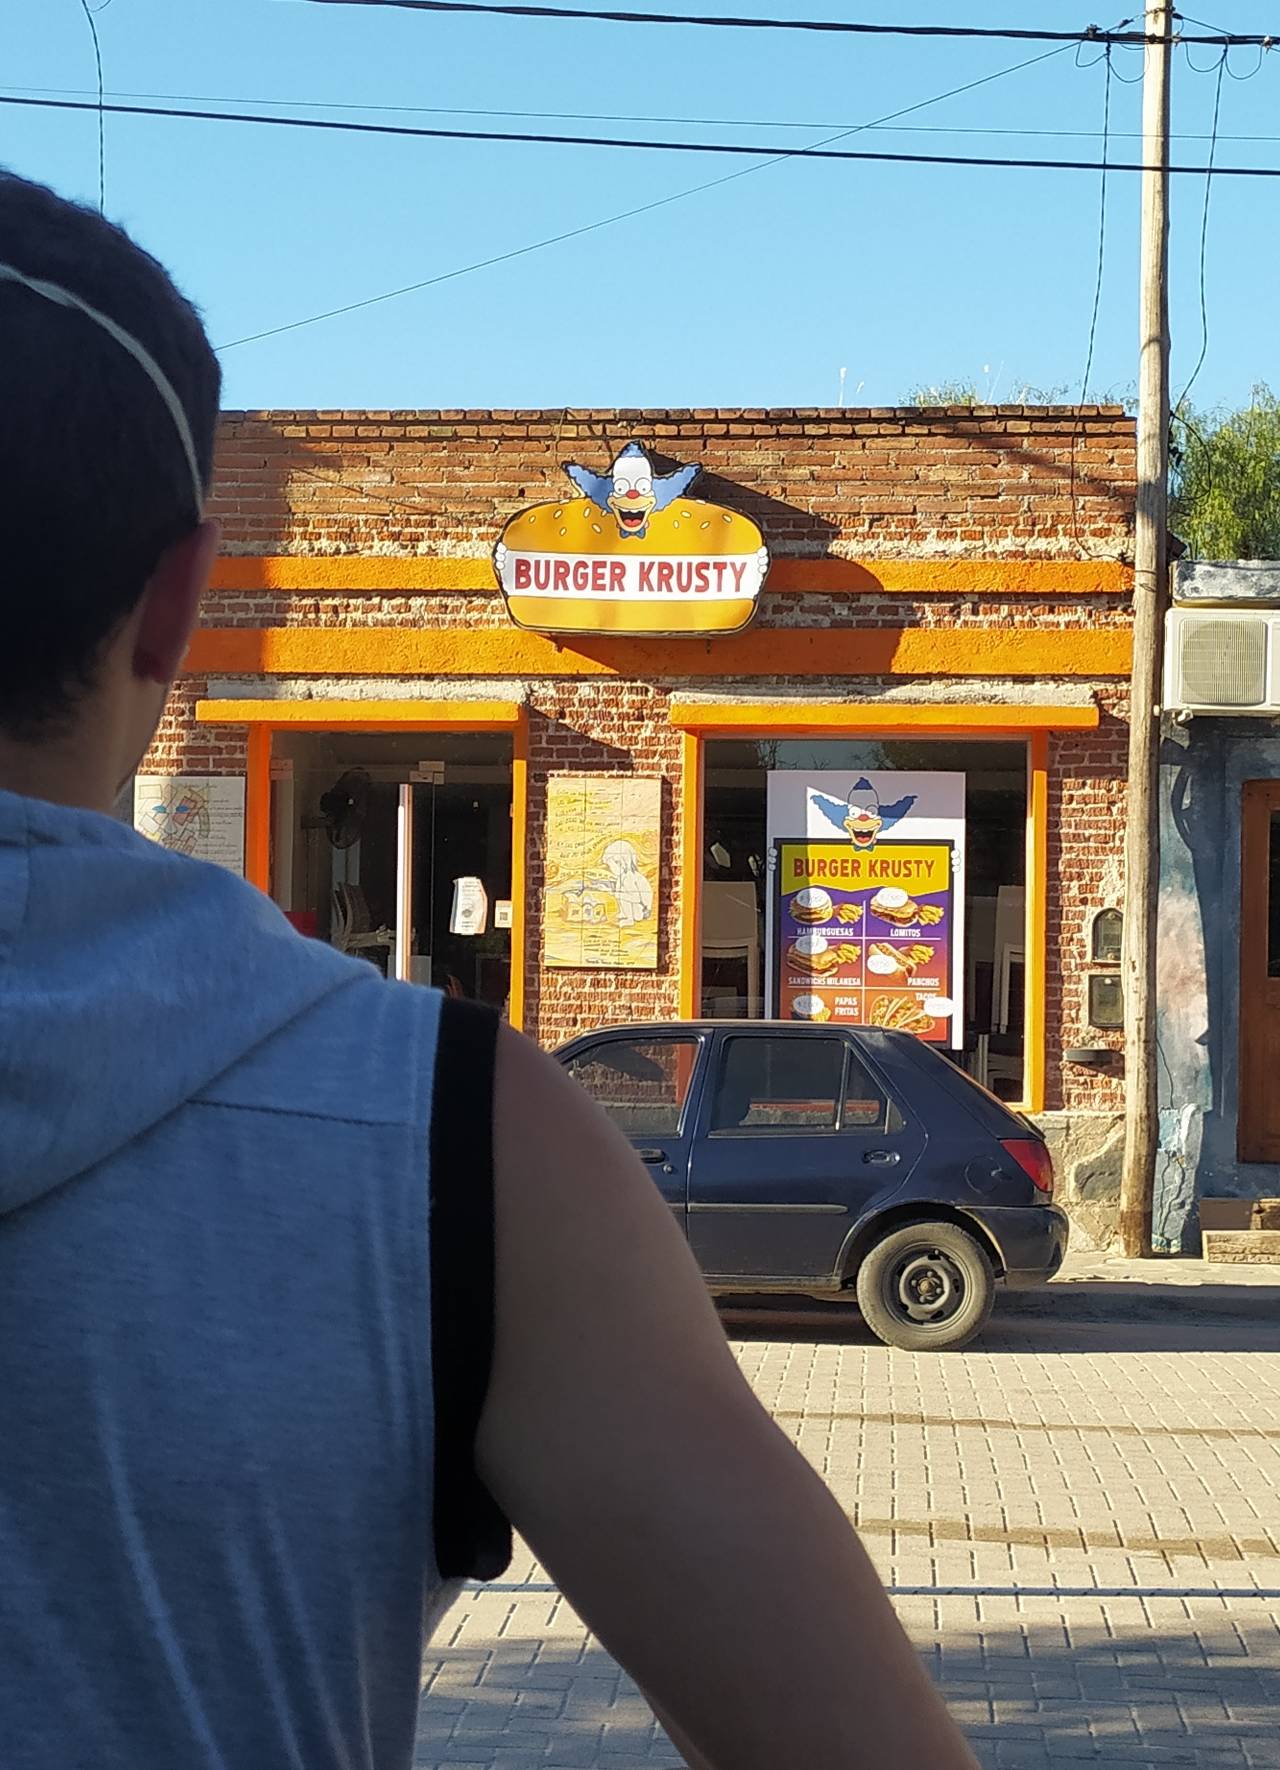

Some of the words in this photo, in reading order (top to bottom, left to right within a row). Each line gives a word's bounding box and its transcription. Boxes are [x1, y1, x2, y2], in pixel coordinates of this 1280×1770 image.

[514, 557, 626, 592] BURGER
[638, 560, 747, 593] KRUSTY
[793, 858, 861, 878] BURGER
[868, 859, 935, 878] KRUSTY
[796, 927, 854, 936] HAMBURGUESAS
[890, 928, 921, 937] LOMITOS
[826, 977, 861, 986] MILANESA
[907, 977, 940, 986] PANCHOS
[834, 996, 858, 1006] PAPAS
[834, 1007, 859, 1016] FRITAS
